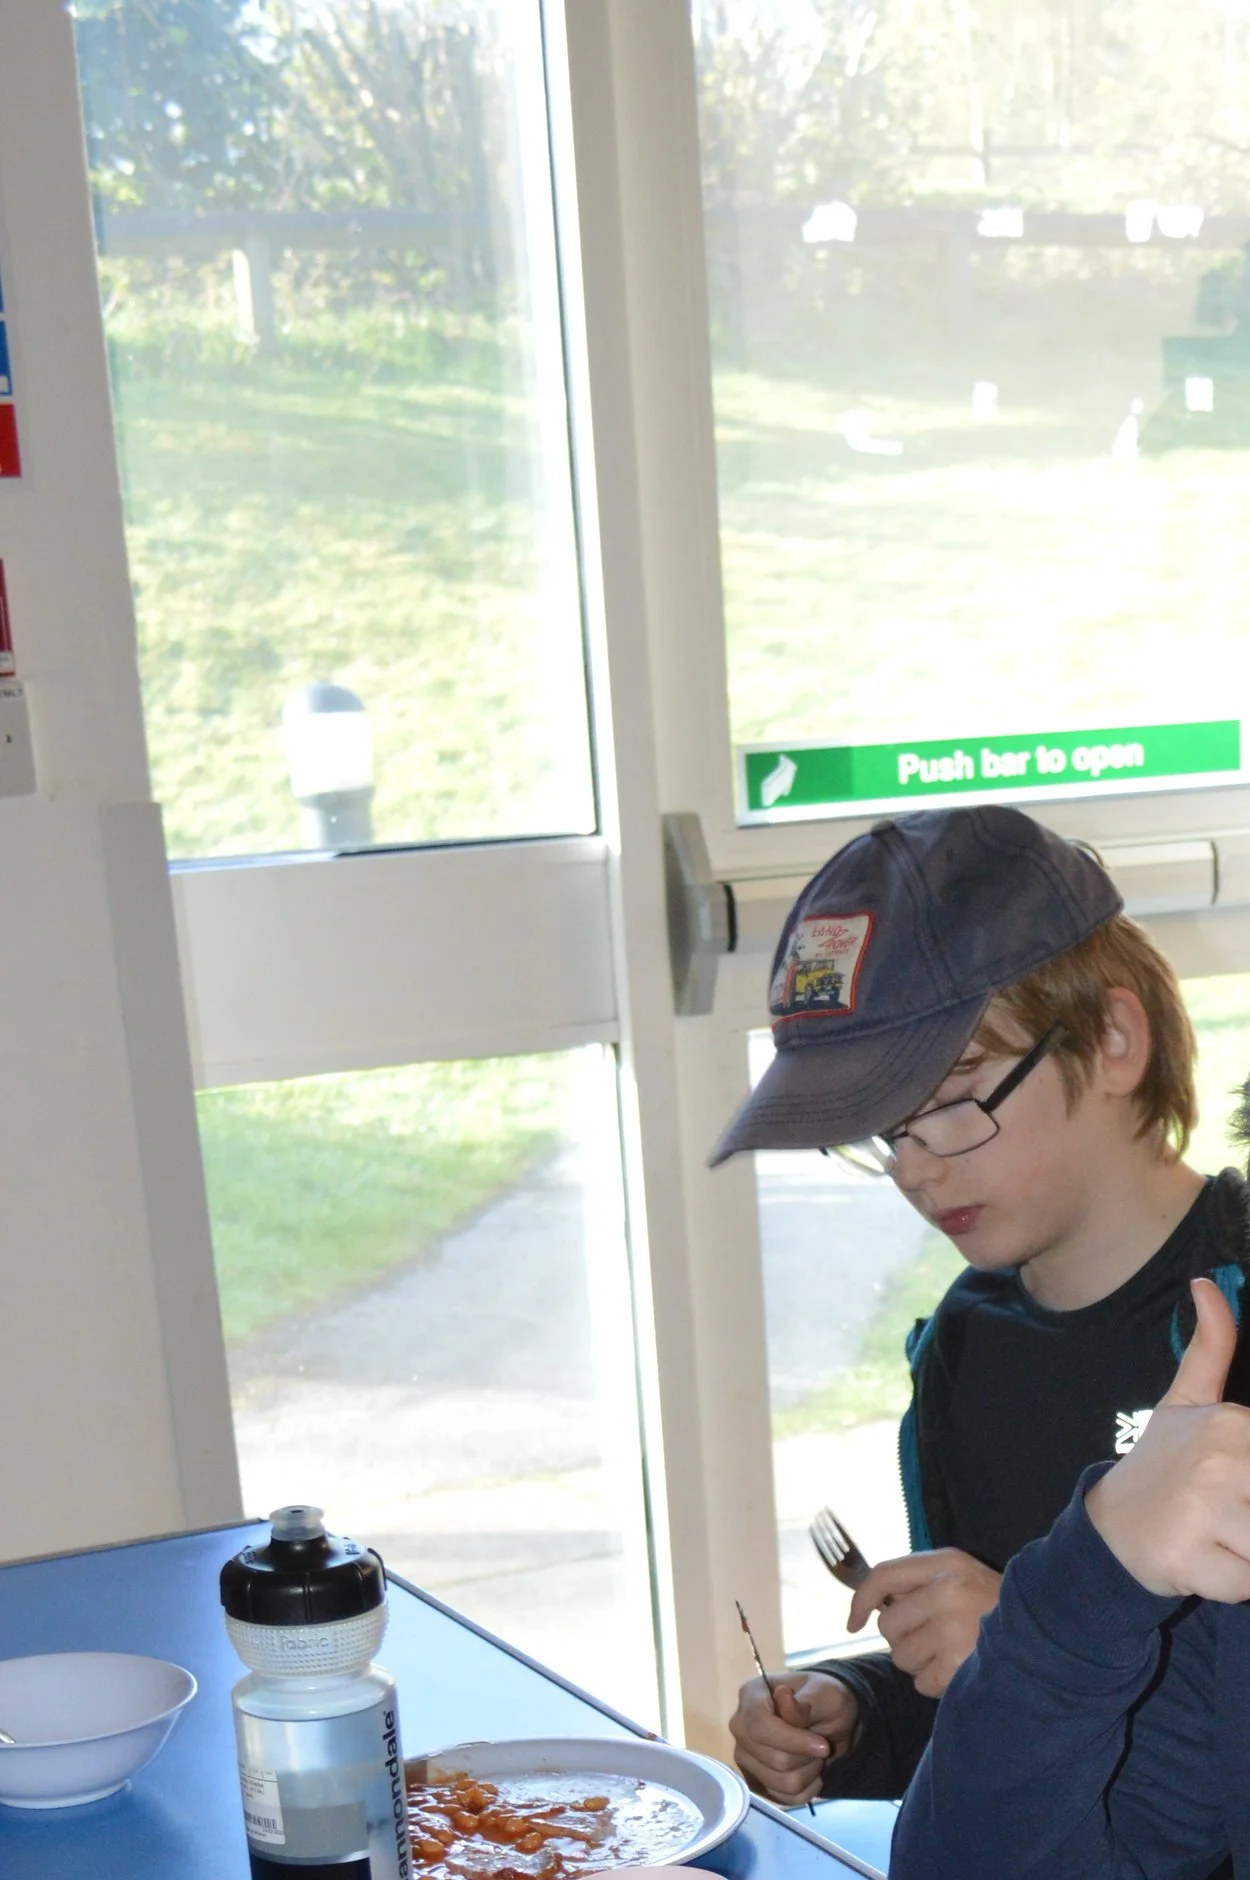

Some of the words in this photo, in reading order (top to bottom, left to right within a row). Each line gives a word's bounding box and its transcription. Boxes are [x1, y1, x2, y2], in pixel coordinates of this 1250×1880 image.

[897, 749, 974, 784] Push
[980, 747, 1031, 777] bar
[1035, 744, 1067, 774] to
[1071, 741, 1144, 777] open
